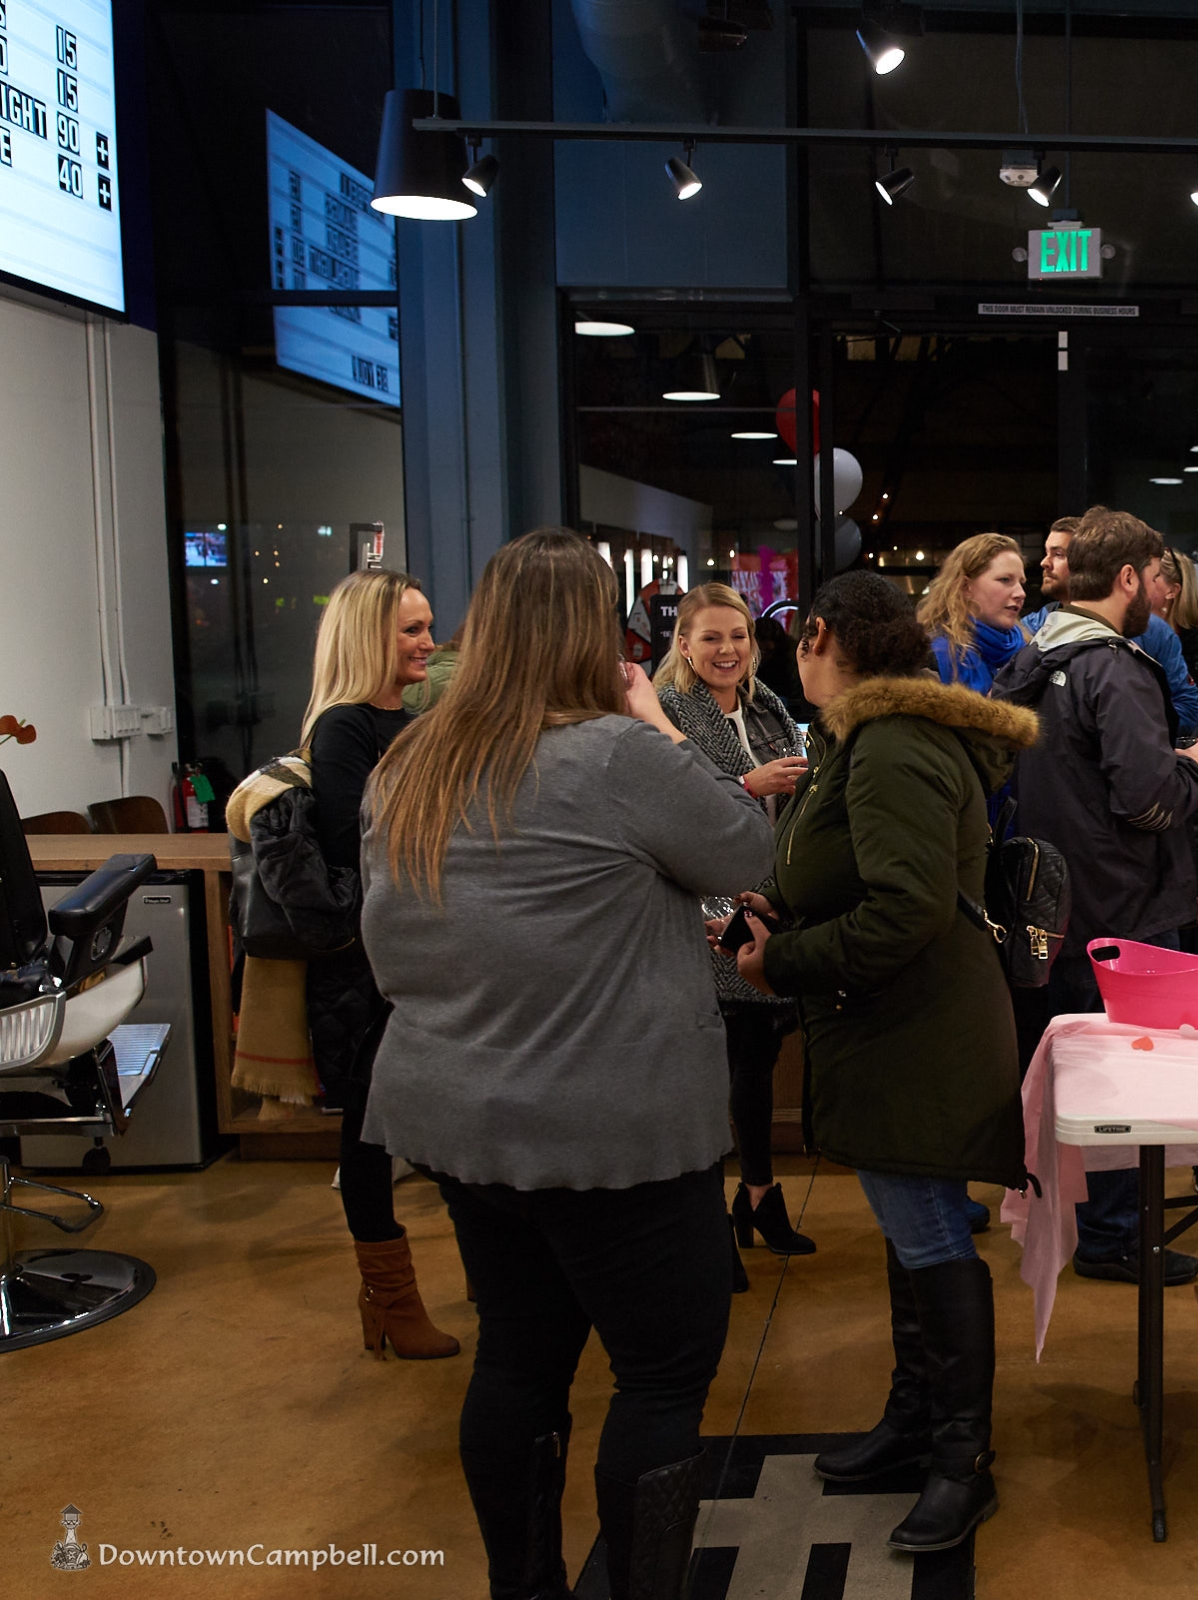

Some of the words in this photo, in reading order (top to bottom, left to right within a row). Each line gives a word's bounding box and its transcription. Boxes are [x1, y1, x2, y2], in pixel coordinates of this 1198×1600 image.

[56, 25, 77, 71] 15
[57, 68, 78, 114] 15
[57, 111, 80, 156] 90
[58, 154, 83, 199] 40
[1040, 230, 1092, 272] EXIT
[982, 304, 993, 313] THIS
[995, 305, 1009, 313] DOOR
[1010, 305, 1024, 313] MUST
[1026, 305, 1044, 314] REMAIN
[1046, 306, 1071, 314] UNLOCKED
[1073, 307, 1091, 315] DURING
[1093, 307, 1117, 315] BUSINESS
[1118, 307, 1135, 315] HOURS
[660, 606, 678, 617] TH
